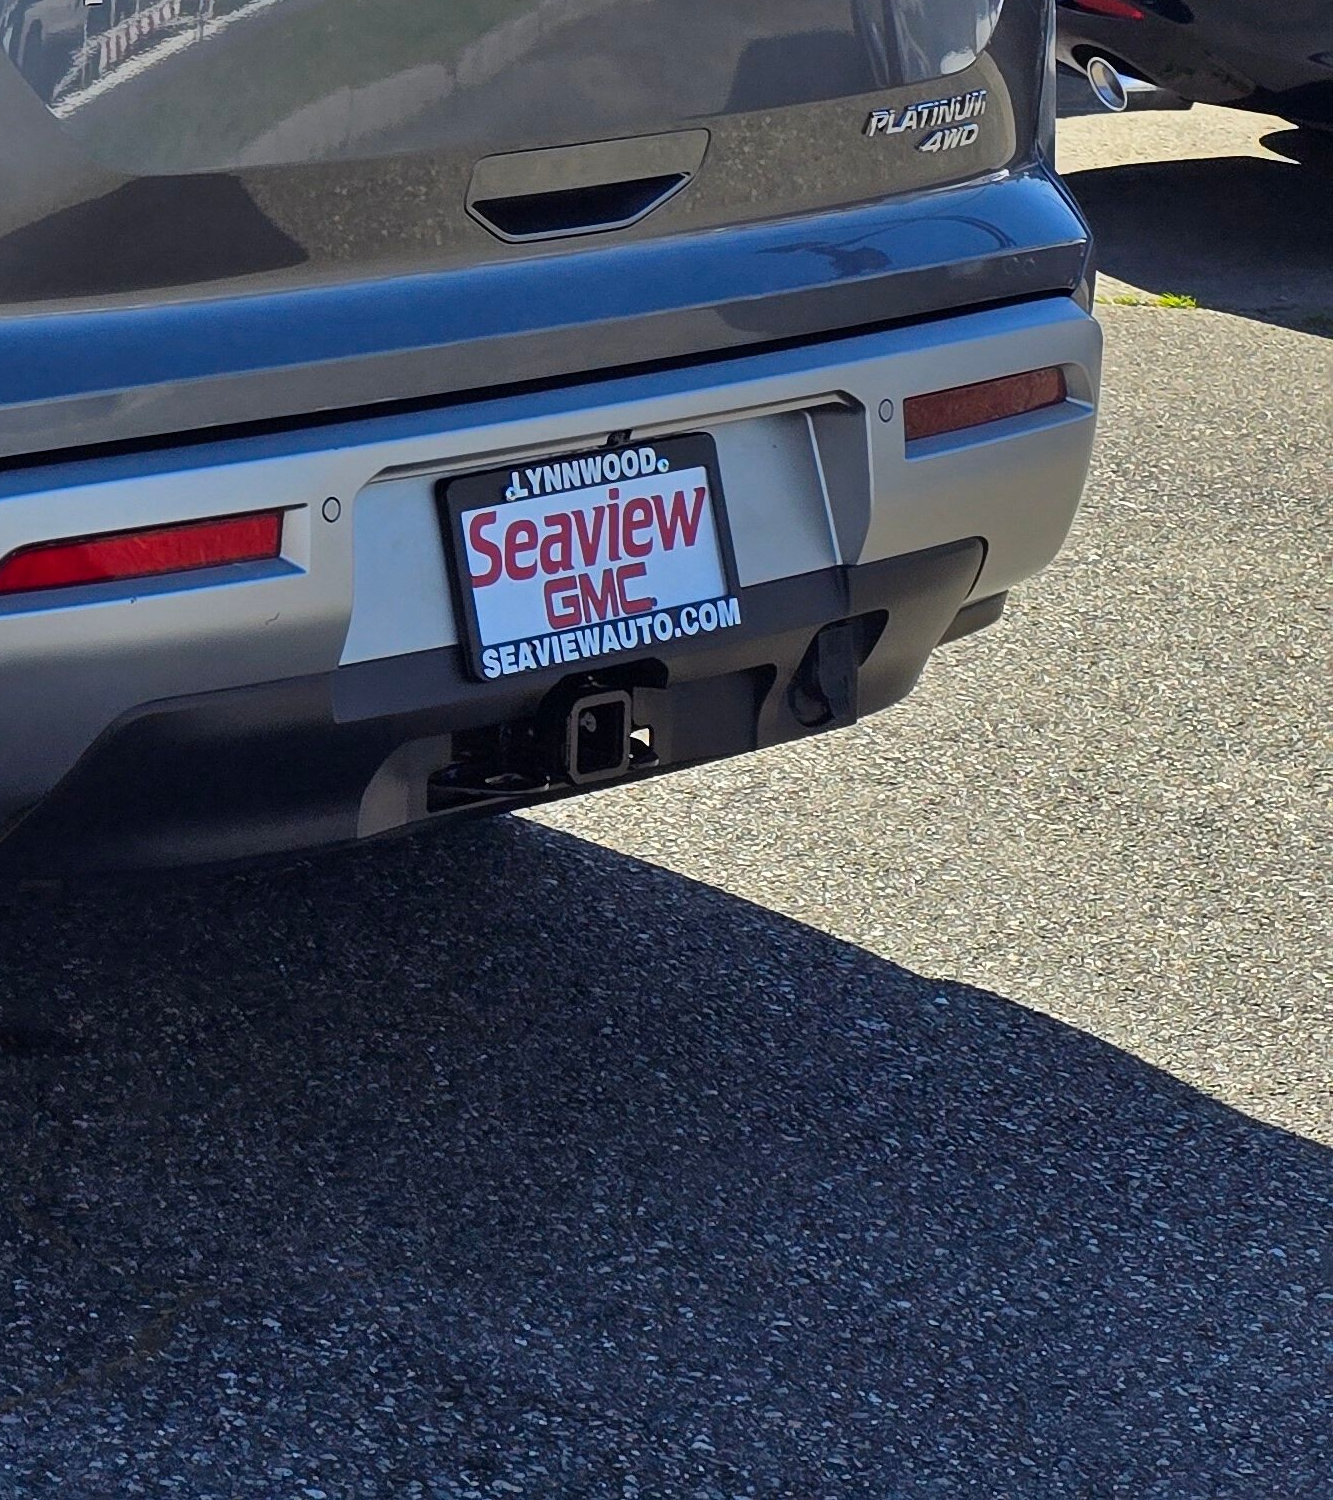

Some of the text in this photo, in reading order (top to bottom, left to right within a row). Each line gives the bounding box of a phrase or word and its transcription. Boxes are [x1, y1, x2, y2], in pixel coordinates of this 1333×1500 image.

[864, 90, 988, 137] PLATINUM
[918, 122, 980, 153] 4WD
[511, 447, 657, 499] LYNNWOOD
[469, 487, 706, 588] Seaview
[544, 562, 655, 630] GMC
[483, 597, 742, 679] SEAVIEWAUTO.COM
